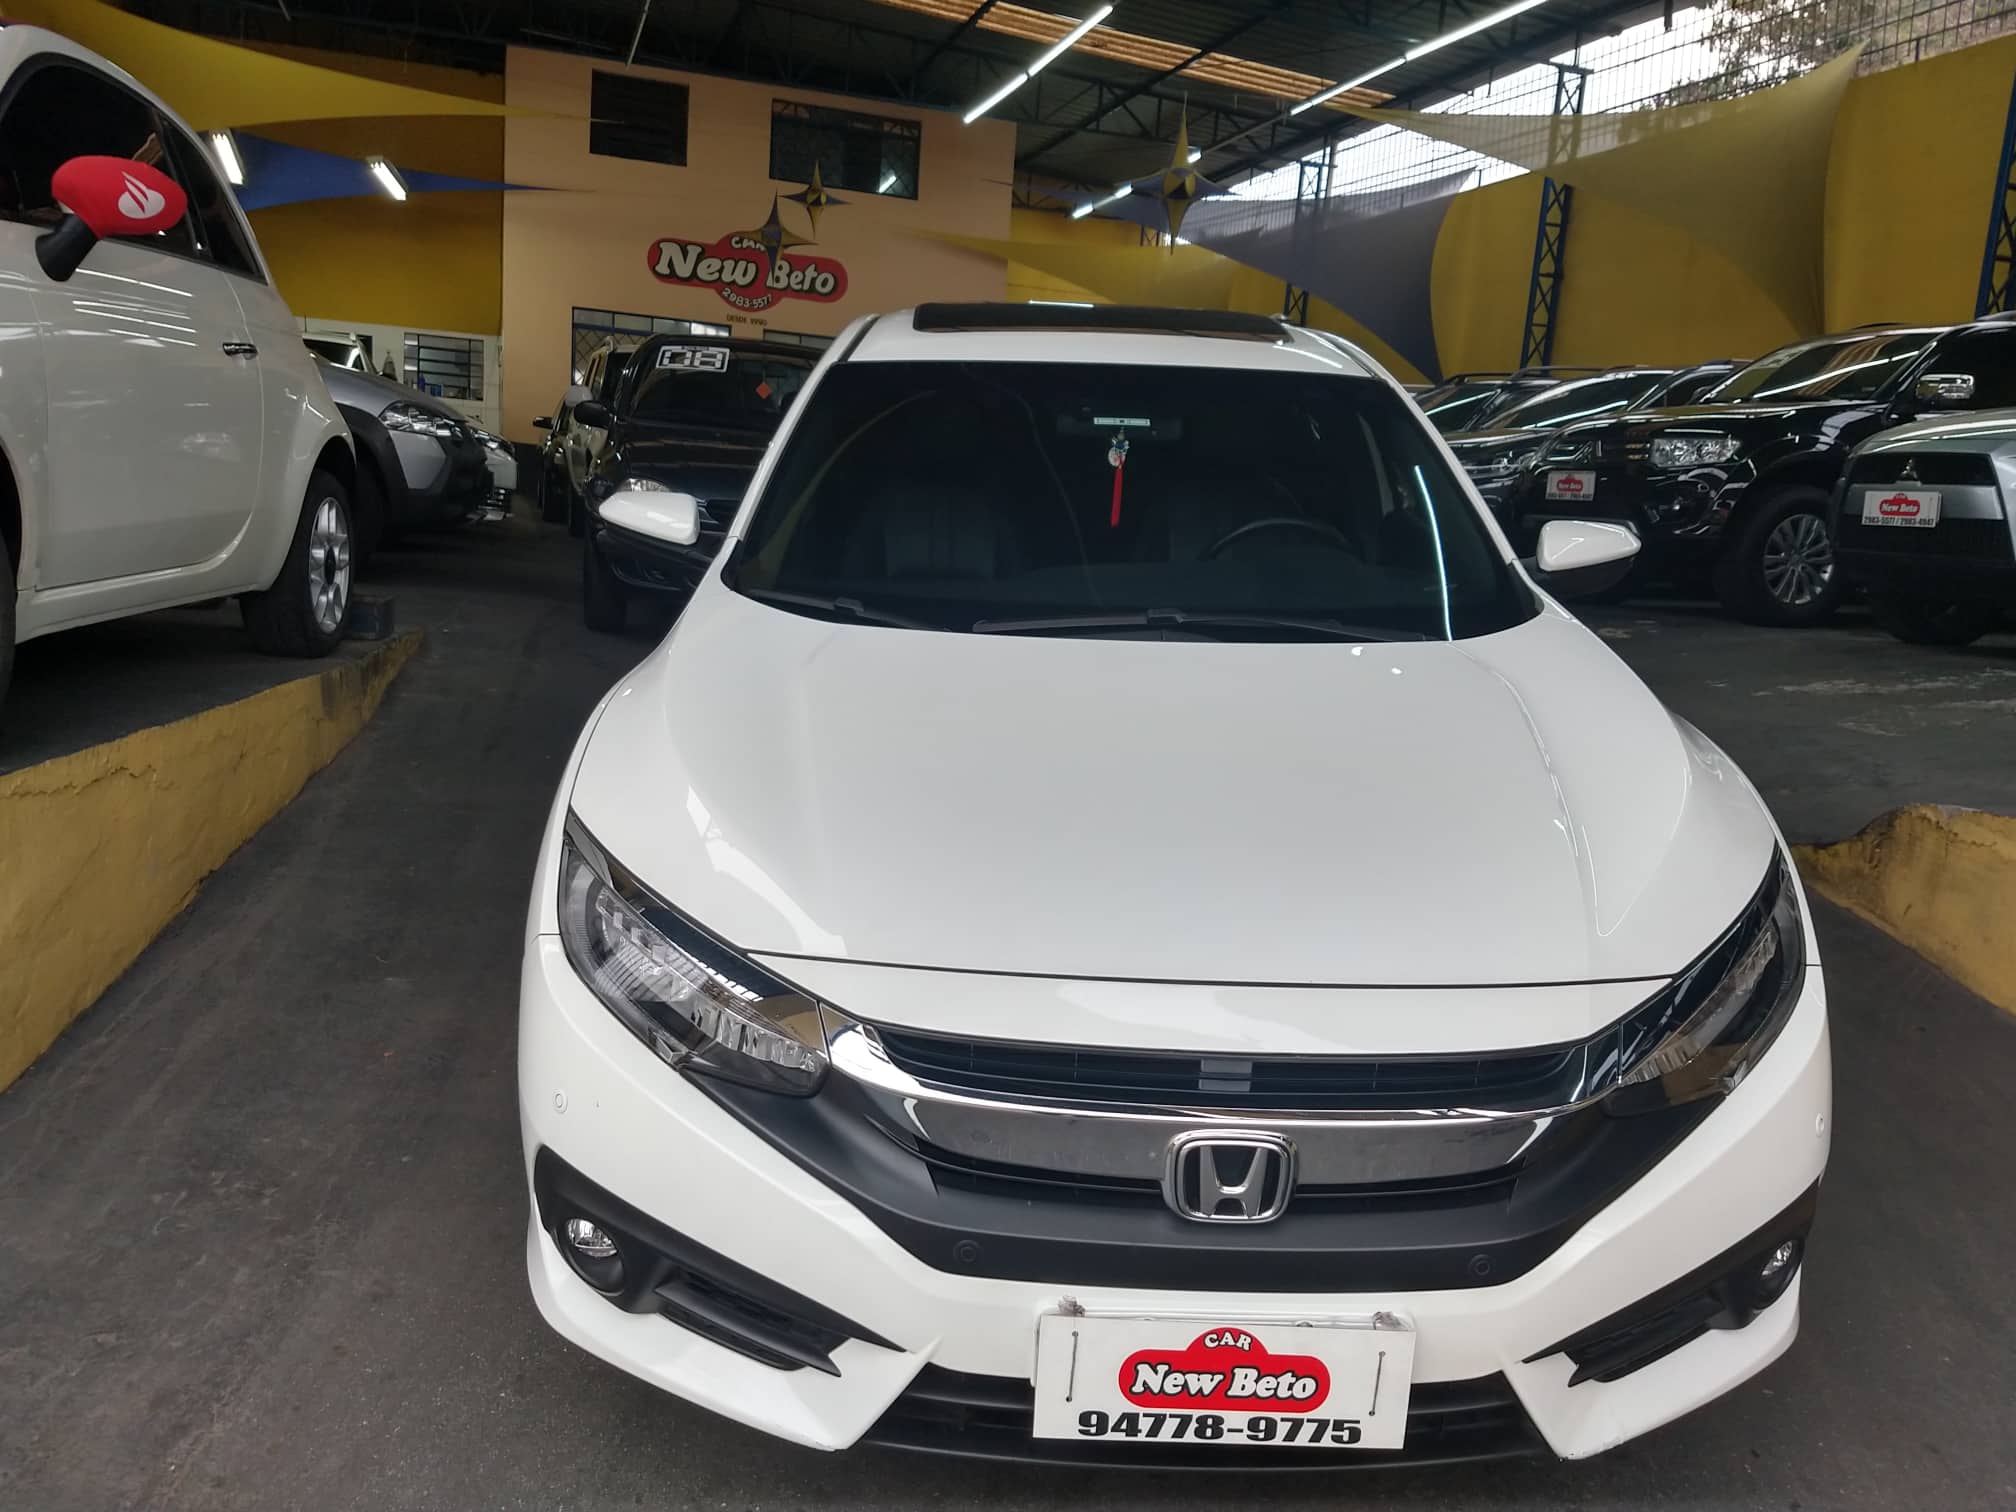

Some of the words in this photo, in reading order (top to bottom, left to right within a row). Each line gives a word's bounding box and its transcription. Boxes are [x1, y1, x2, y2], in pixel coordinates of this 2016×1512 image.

[654, 241, 757, 287] New
[766, 260, 836, 295] Beto
[1881, 503, 1899, 512] New
[1900, 503, 1919, 513] Beto
[1203, 1332, 1252, 1351] CAR
[1130, 1363, 1224, 1397] New
[1226, 1367, 1319, 1401] Beto
[1078, 1410, 1362, 1445] 94778-9775
